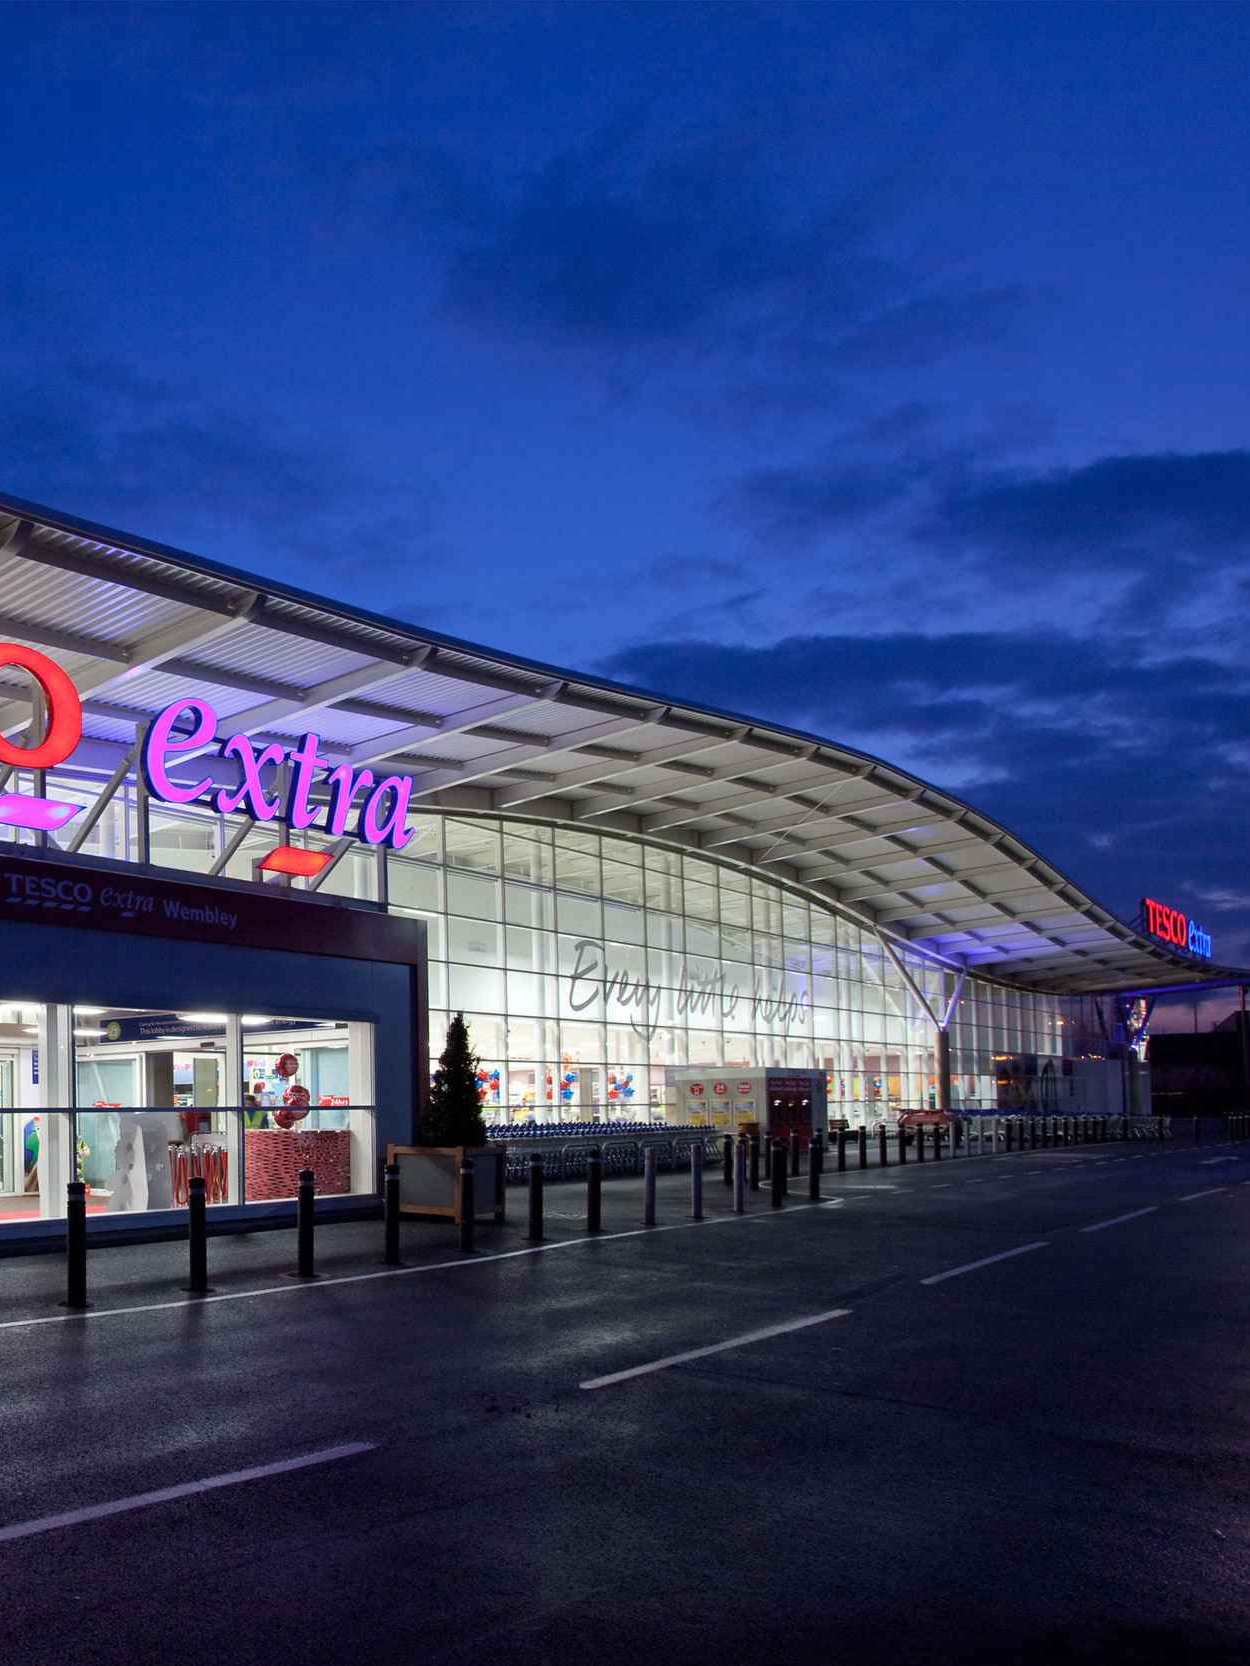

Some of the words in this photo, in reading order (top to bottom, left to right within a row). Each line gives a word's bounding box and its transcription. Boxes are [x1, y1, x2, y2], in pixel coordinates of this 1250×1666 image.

[146, 697, 416, 849] extra
[3, 871, 93, 903] TESCO
[100, 885, 155, 913] extra
[162, 898, 238, 930] Wembley
[1145, 898, 1187, 947] TESCO
[1188, 920, 1212, 959] extra
[568, 940, 661, 1042] Every
[677, 964, 740, 1020] little
[750, 974, 809, 1036] helps
[170, 1024, 196, 1033] designed
